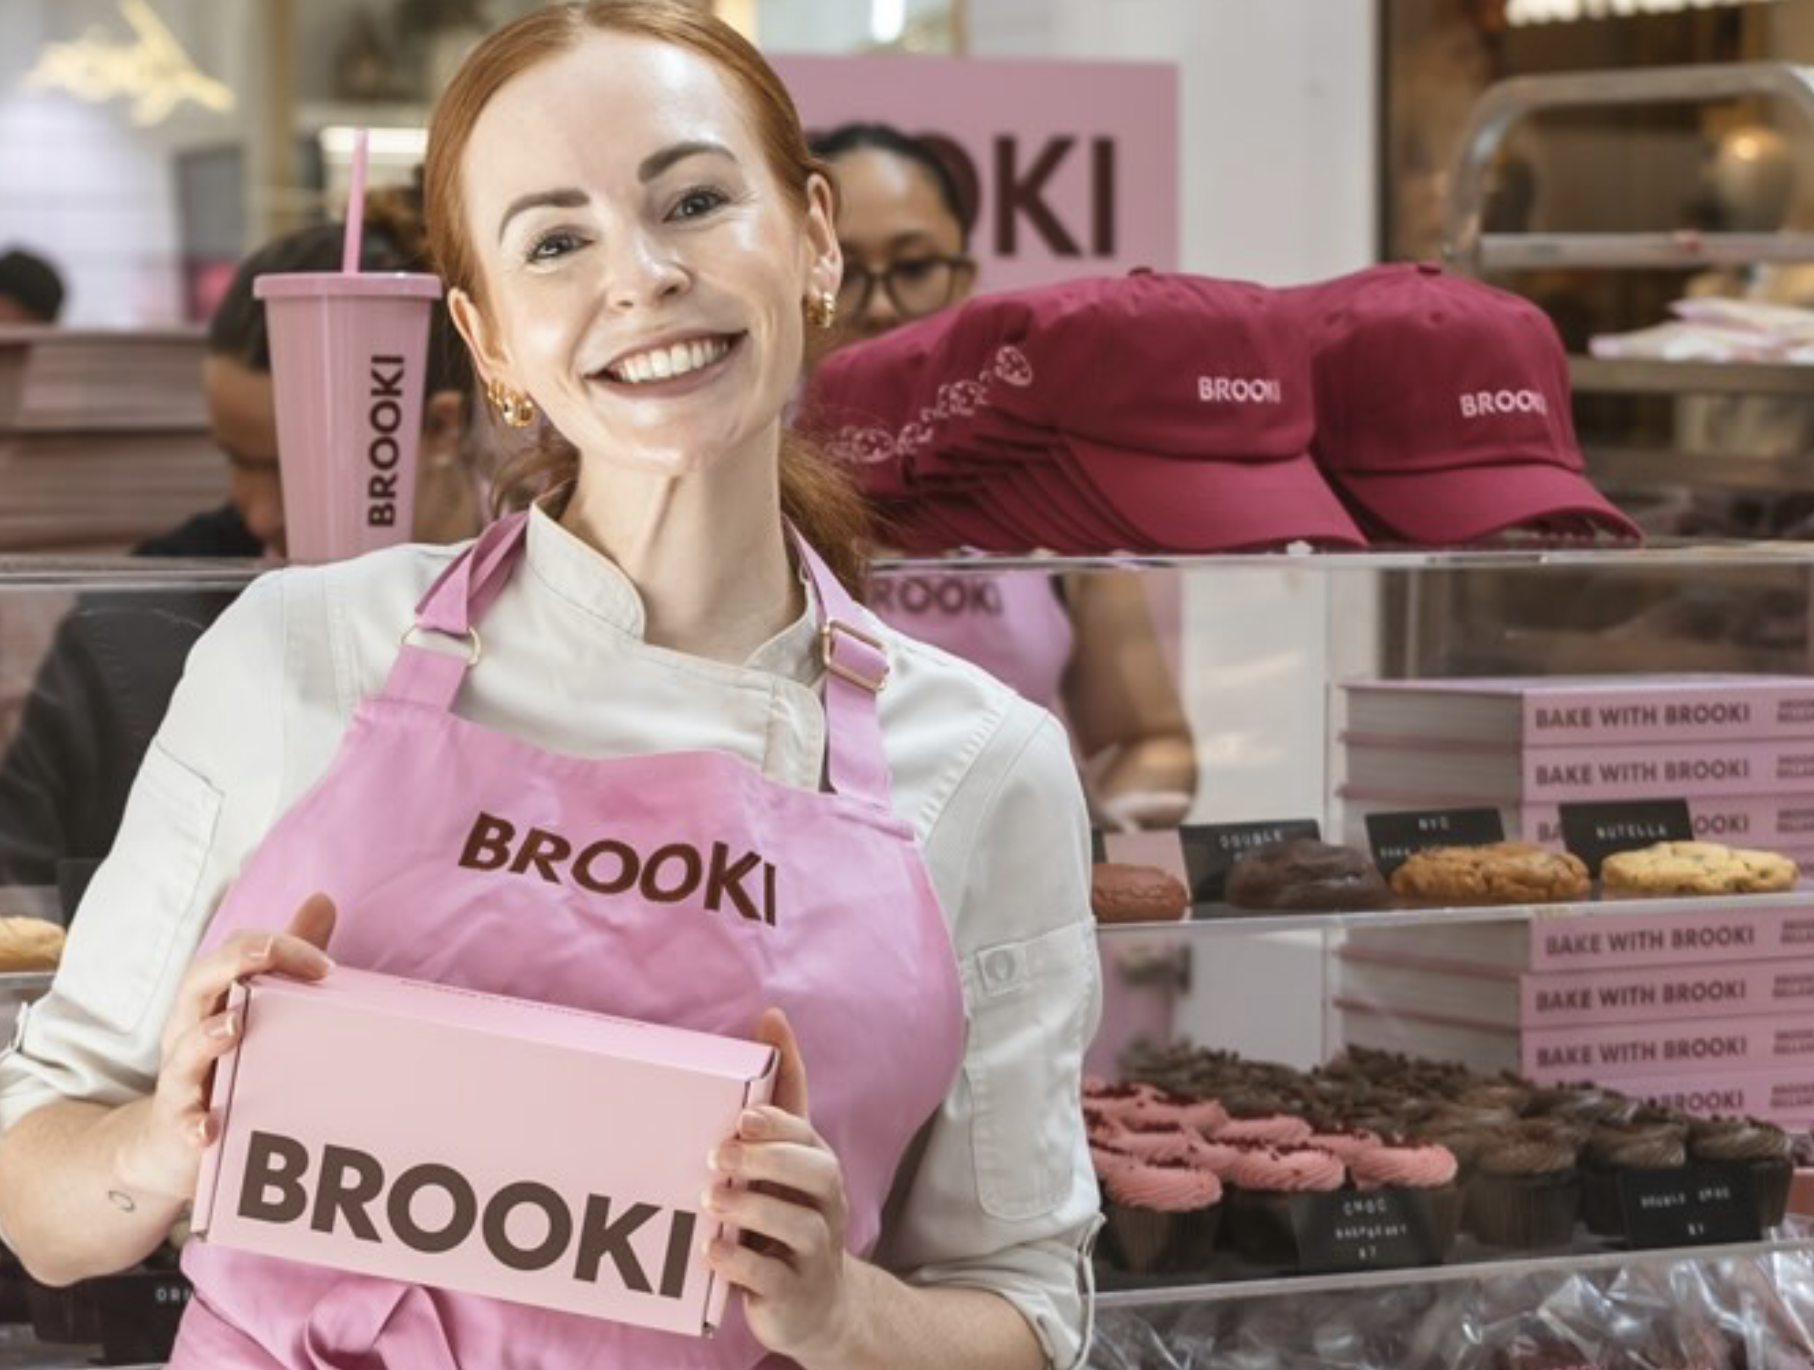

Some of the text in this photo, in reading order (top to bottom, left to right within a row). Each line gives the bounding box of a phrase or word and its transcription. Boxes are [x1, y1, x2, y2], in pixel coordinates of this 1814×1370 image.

[368, 355, 405, 527] BROOKI
[1535, 702, 1749, 729] BAKE WITH BROOKI
[1535, 759, 1749, 786] BAKE WITH BROOKI
[1596, 824, 1668, 839] NUTELLA
[458, 811, 777, 927] BROOKI
[1545, 925, 1755, 956] BAKE WITH BROOKI
[1535, 989, 1592, 1012] BAKE
[1600, 986, 1656, 1007] WITH
[1663, 980, 1747, 1003] BROOKI
[1536, 1046, 1592, 1068] BAKE
[1600, 1042, 1657, 1063] WITH
[1663, 1036, 1748, 1059] BROOKI
[237, 1130, 697, 1299] BROOKI
